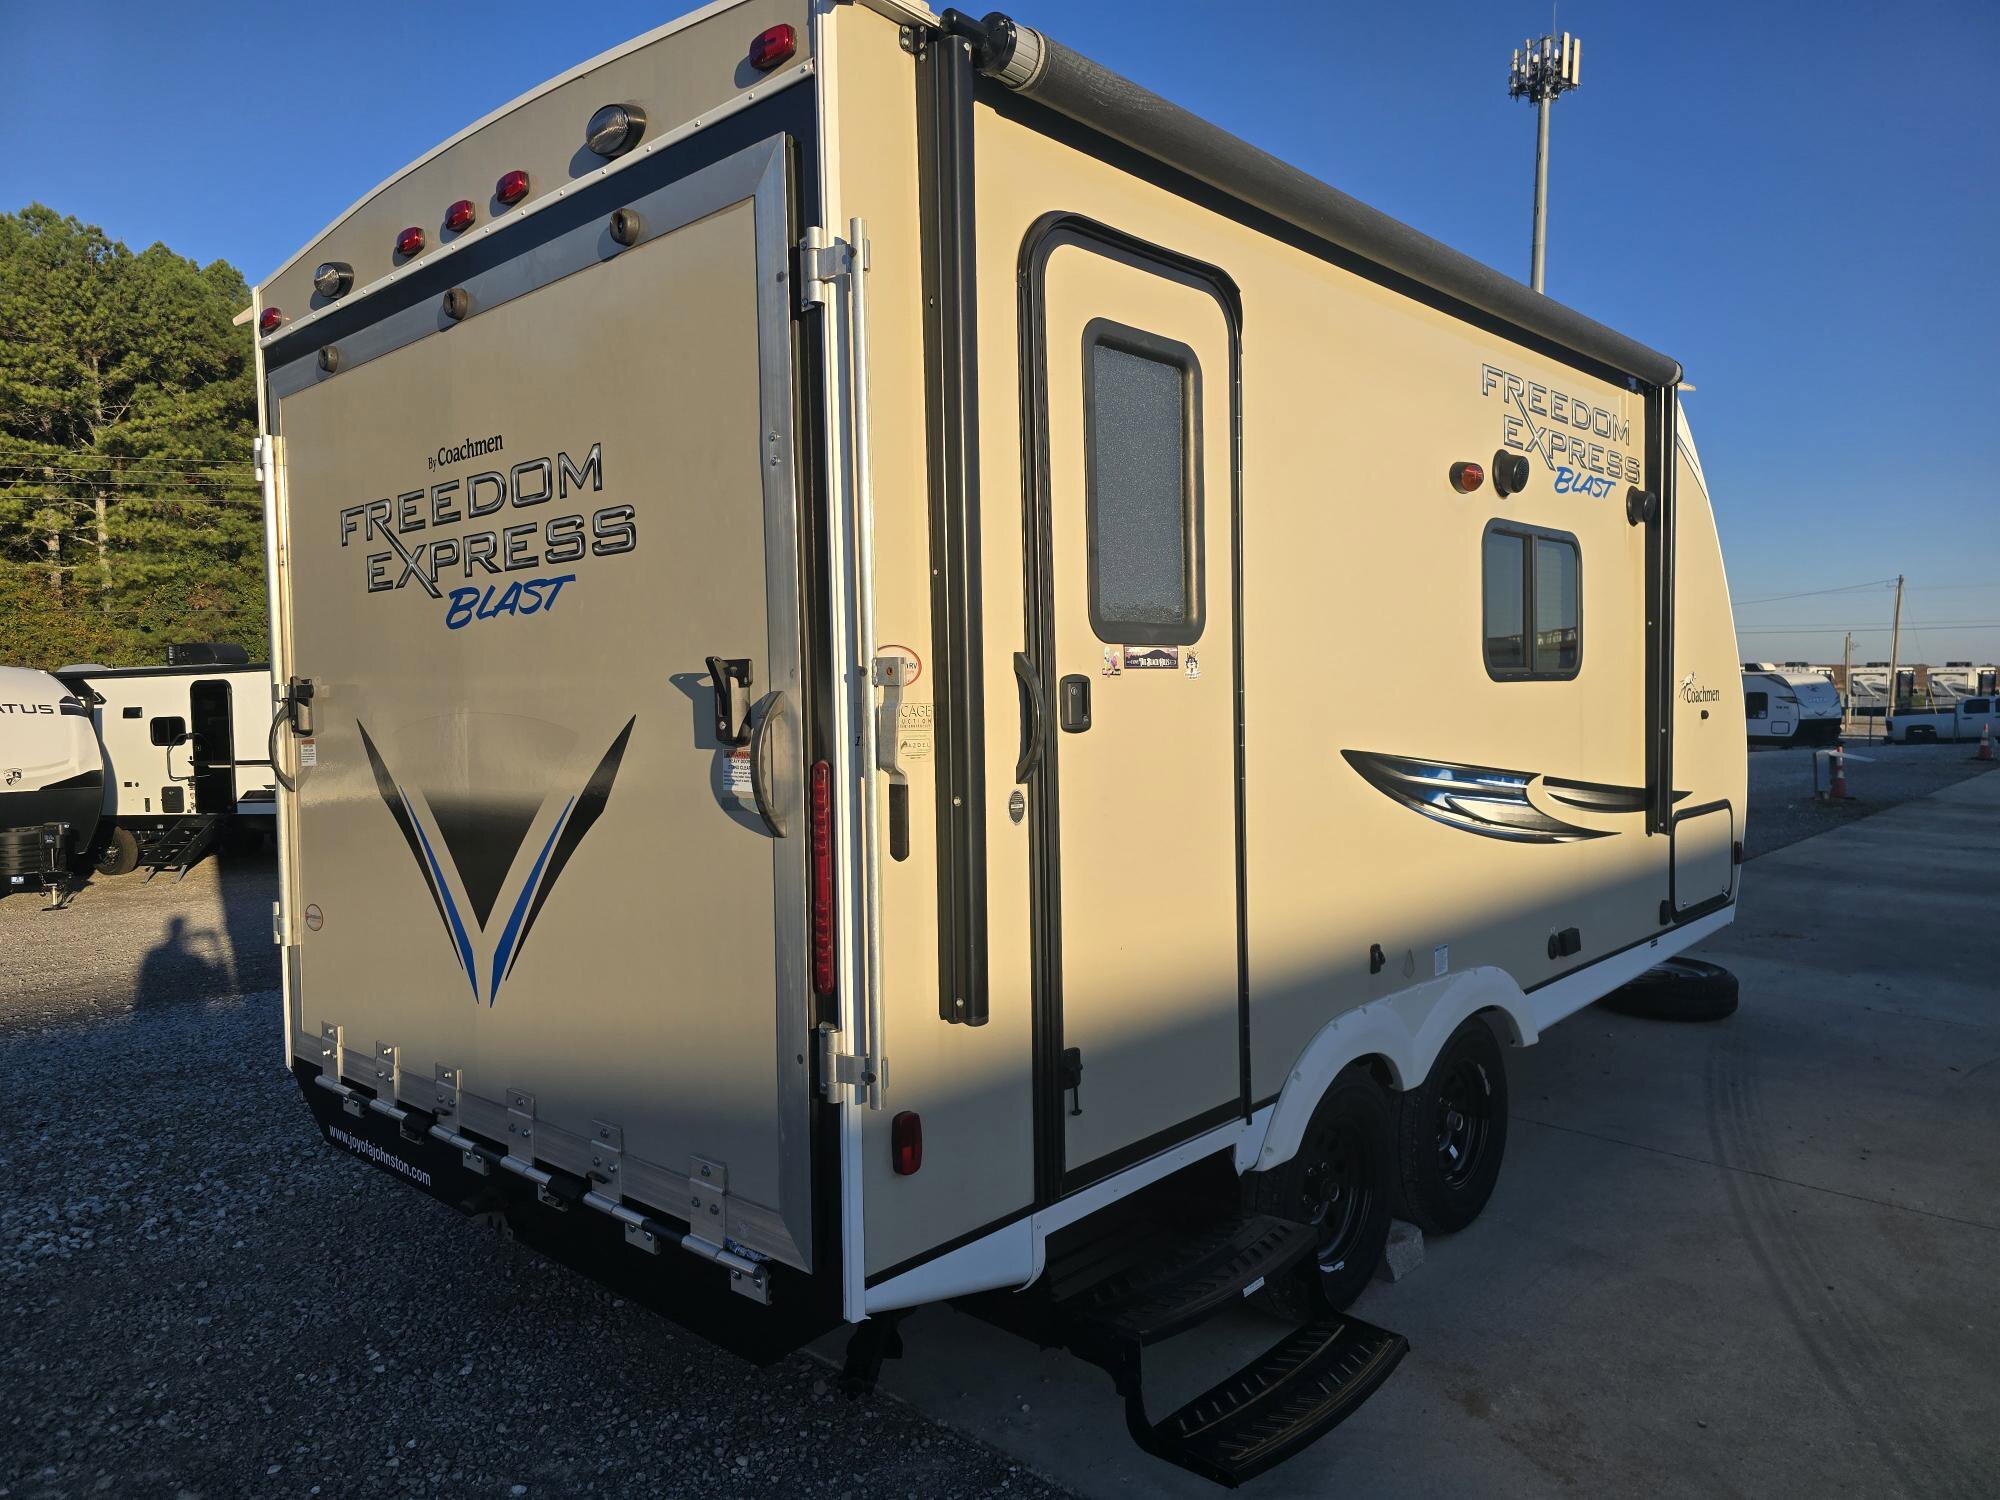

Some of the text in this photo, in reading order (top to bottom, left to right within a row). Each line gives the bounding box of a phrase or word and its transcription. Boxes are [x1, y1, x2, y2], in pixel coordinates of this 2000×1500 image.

[1481, 363, 1631, 446] FREEDOM
[428, 434, 503, 472] By Coachmen
[1503, 413, 1641, 485] EXPRESS
[340, 442, 603, 547] FREEDOM
[1554, 466, 1617, 498] BLAST
[367, 504, 637, 599] EXPRESS
[445, 574, 577, 630] BLAST
[1686, 686, 1720, 703] Coachmen
